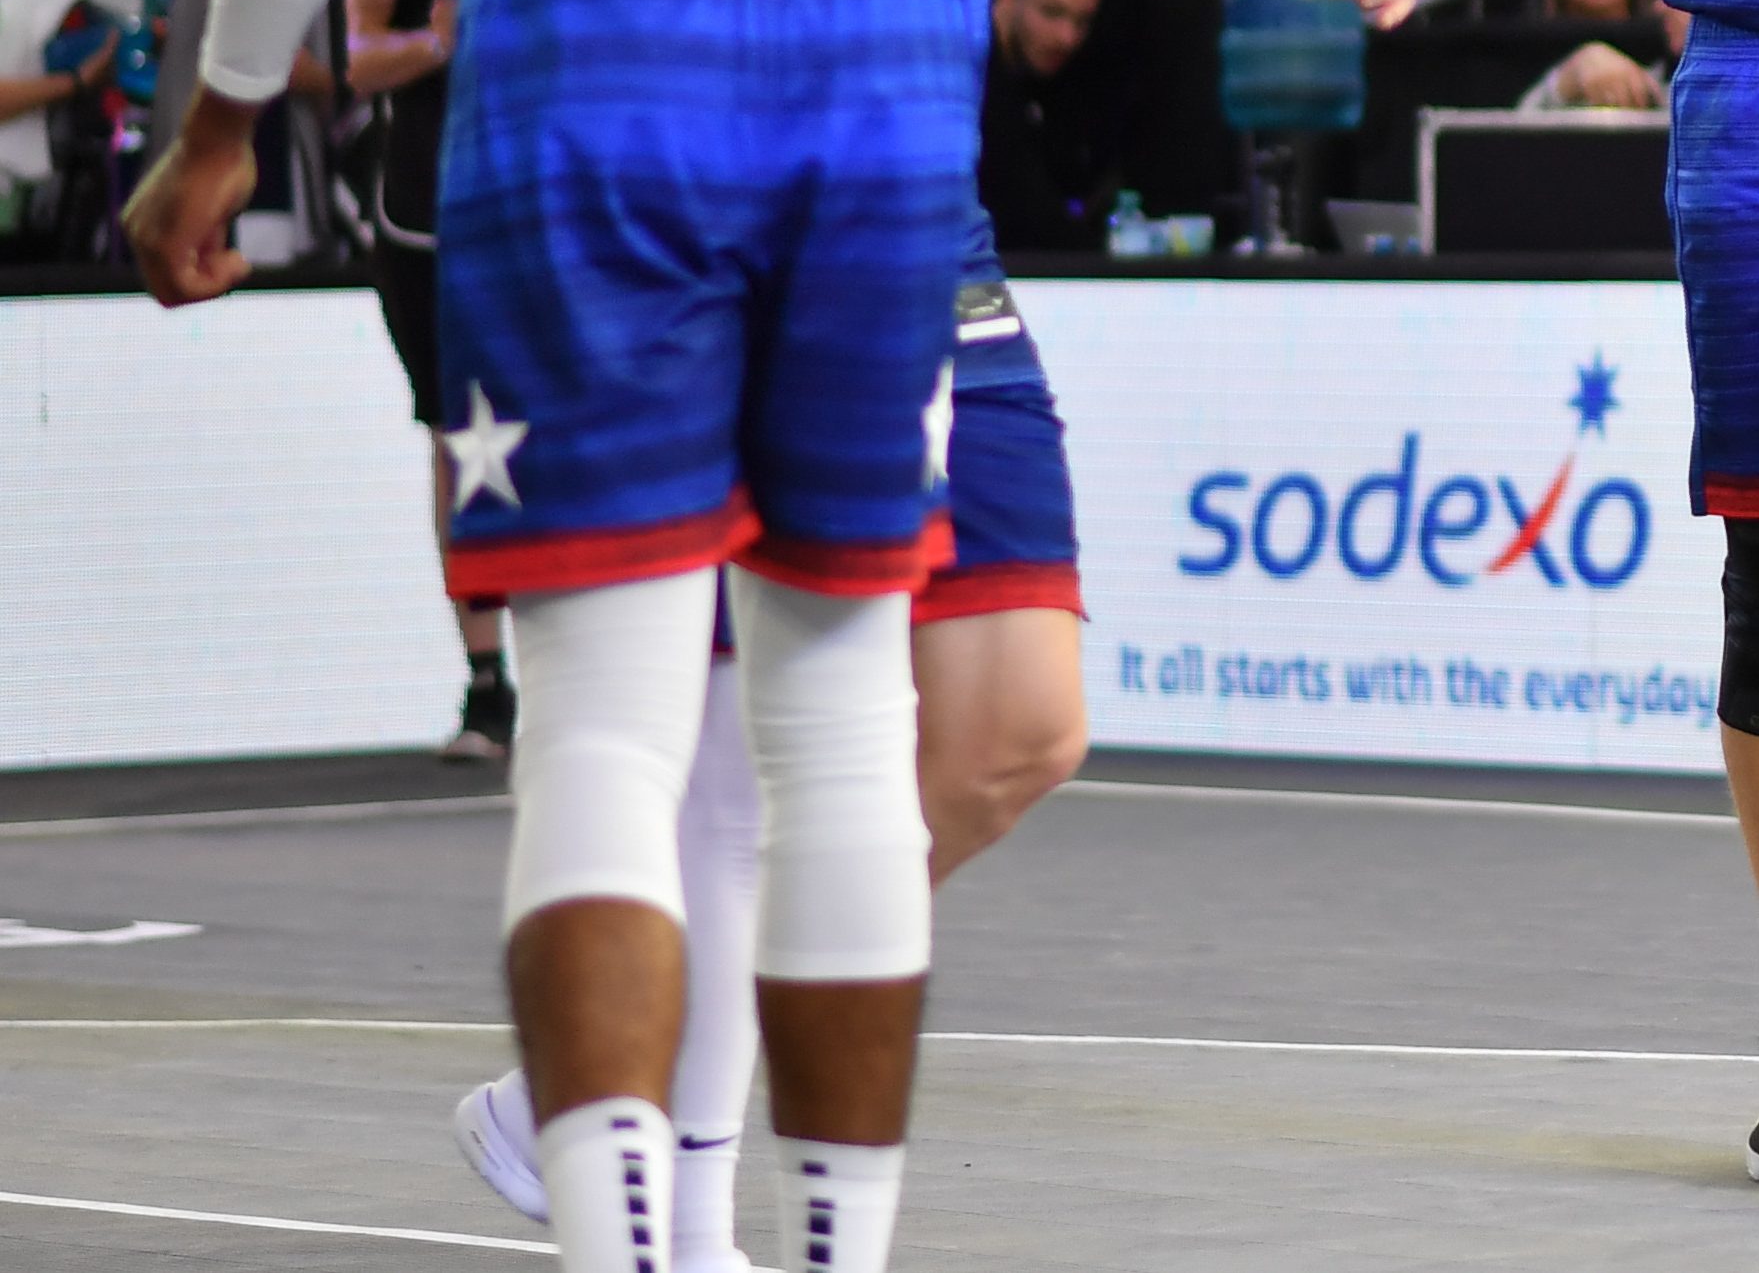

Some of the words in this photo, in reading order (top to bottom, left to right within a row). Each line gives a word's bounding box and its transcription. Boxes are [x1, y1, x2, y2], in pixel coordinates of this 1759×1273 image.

[1177, 430, 1652, 590] sodexo
[1121, 644, 1145, 693] It
[1158, 644, 1204, 695] all
[1216, 650, 1331, 702] starts
[1345, 654, 1432, 705] with
[1447, 655, 1511, 709] the
[1524, 663, 1715, 728] everyday
